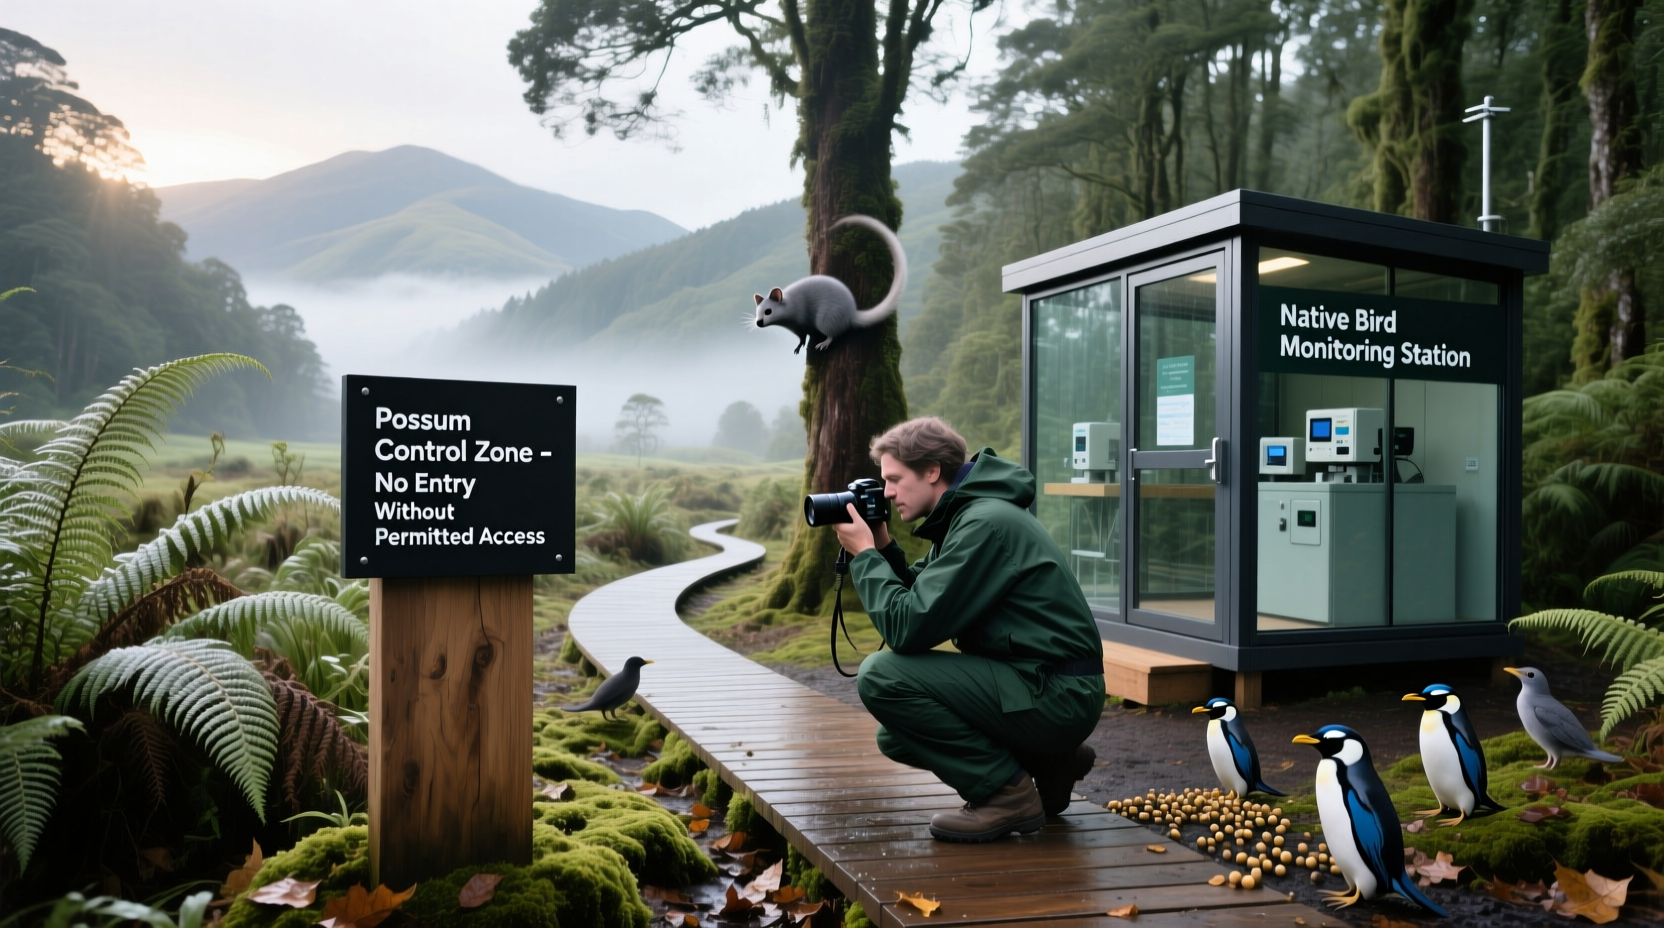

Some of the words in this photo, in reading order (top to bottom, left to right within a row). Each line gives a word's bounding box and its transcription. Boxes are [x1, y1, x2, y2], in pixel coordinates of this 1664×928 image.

[1280, 303, 1350, 331] Native
[1355, 308, 1397, 334] Bird
[1280, 333, 1395, 369] Monitoring
[1401, 341, 1471, 368] Station
[375, 406, 471, 432] Possum
[374, 438, 467, 462] Control
[473, 440, 534, 463] Zone
[375, 471, 409, 494] No
[415, 472, 477, 500] Entry
[374, 501, 455, 521] Without
[375, 526, 474, 546] Permitted
[478, 526, 546, 546] Access
